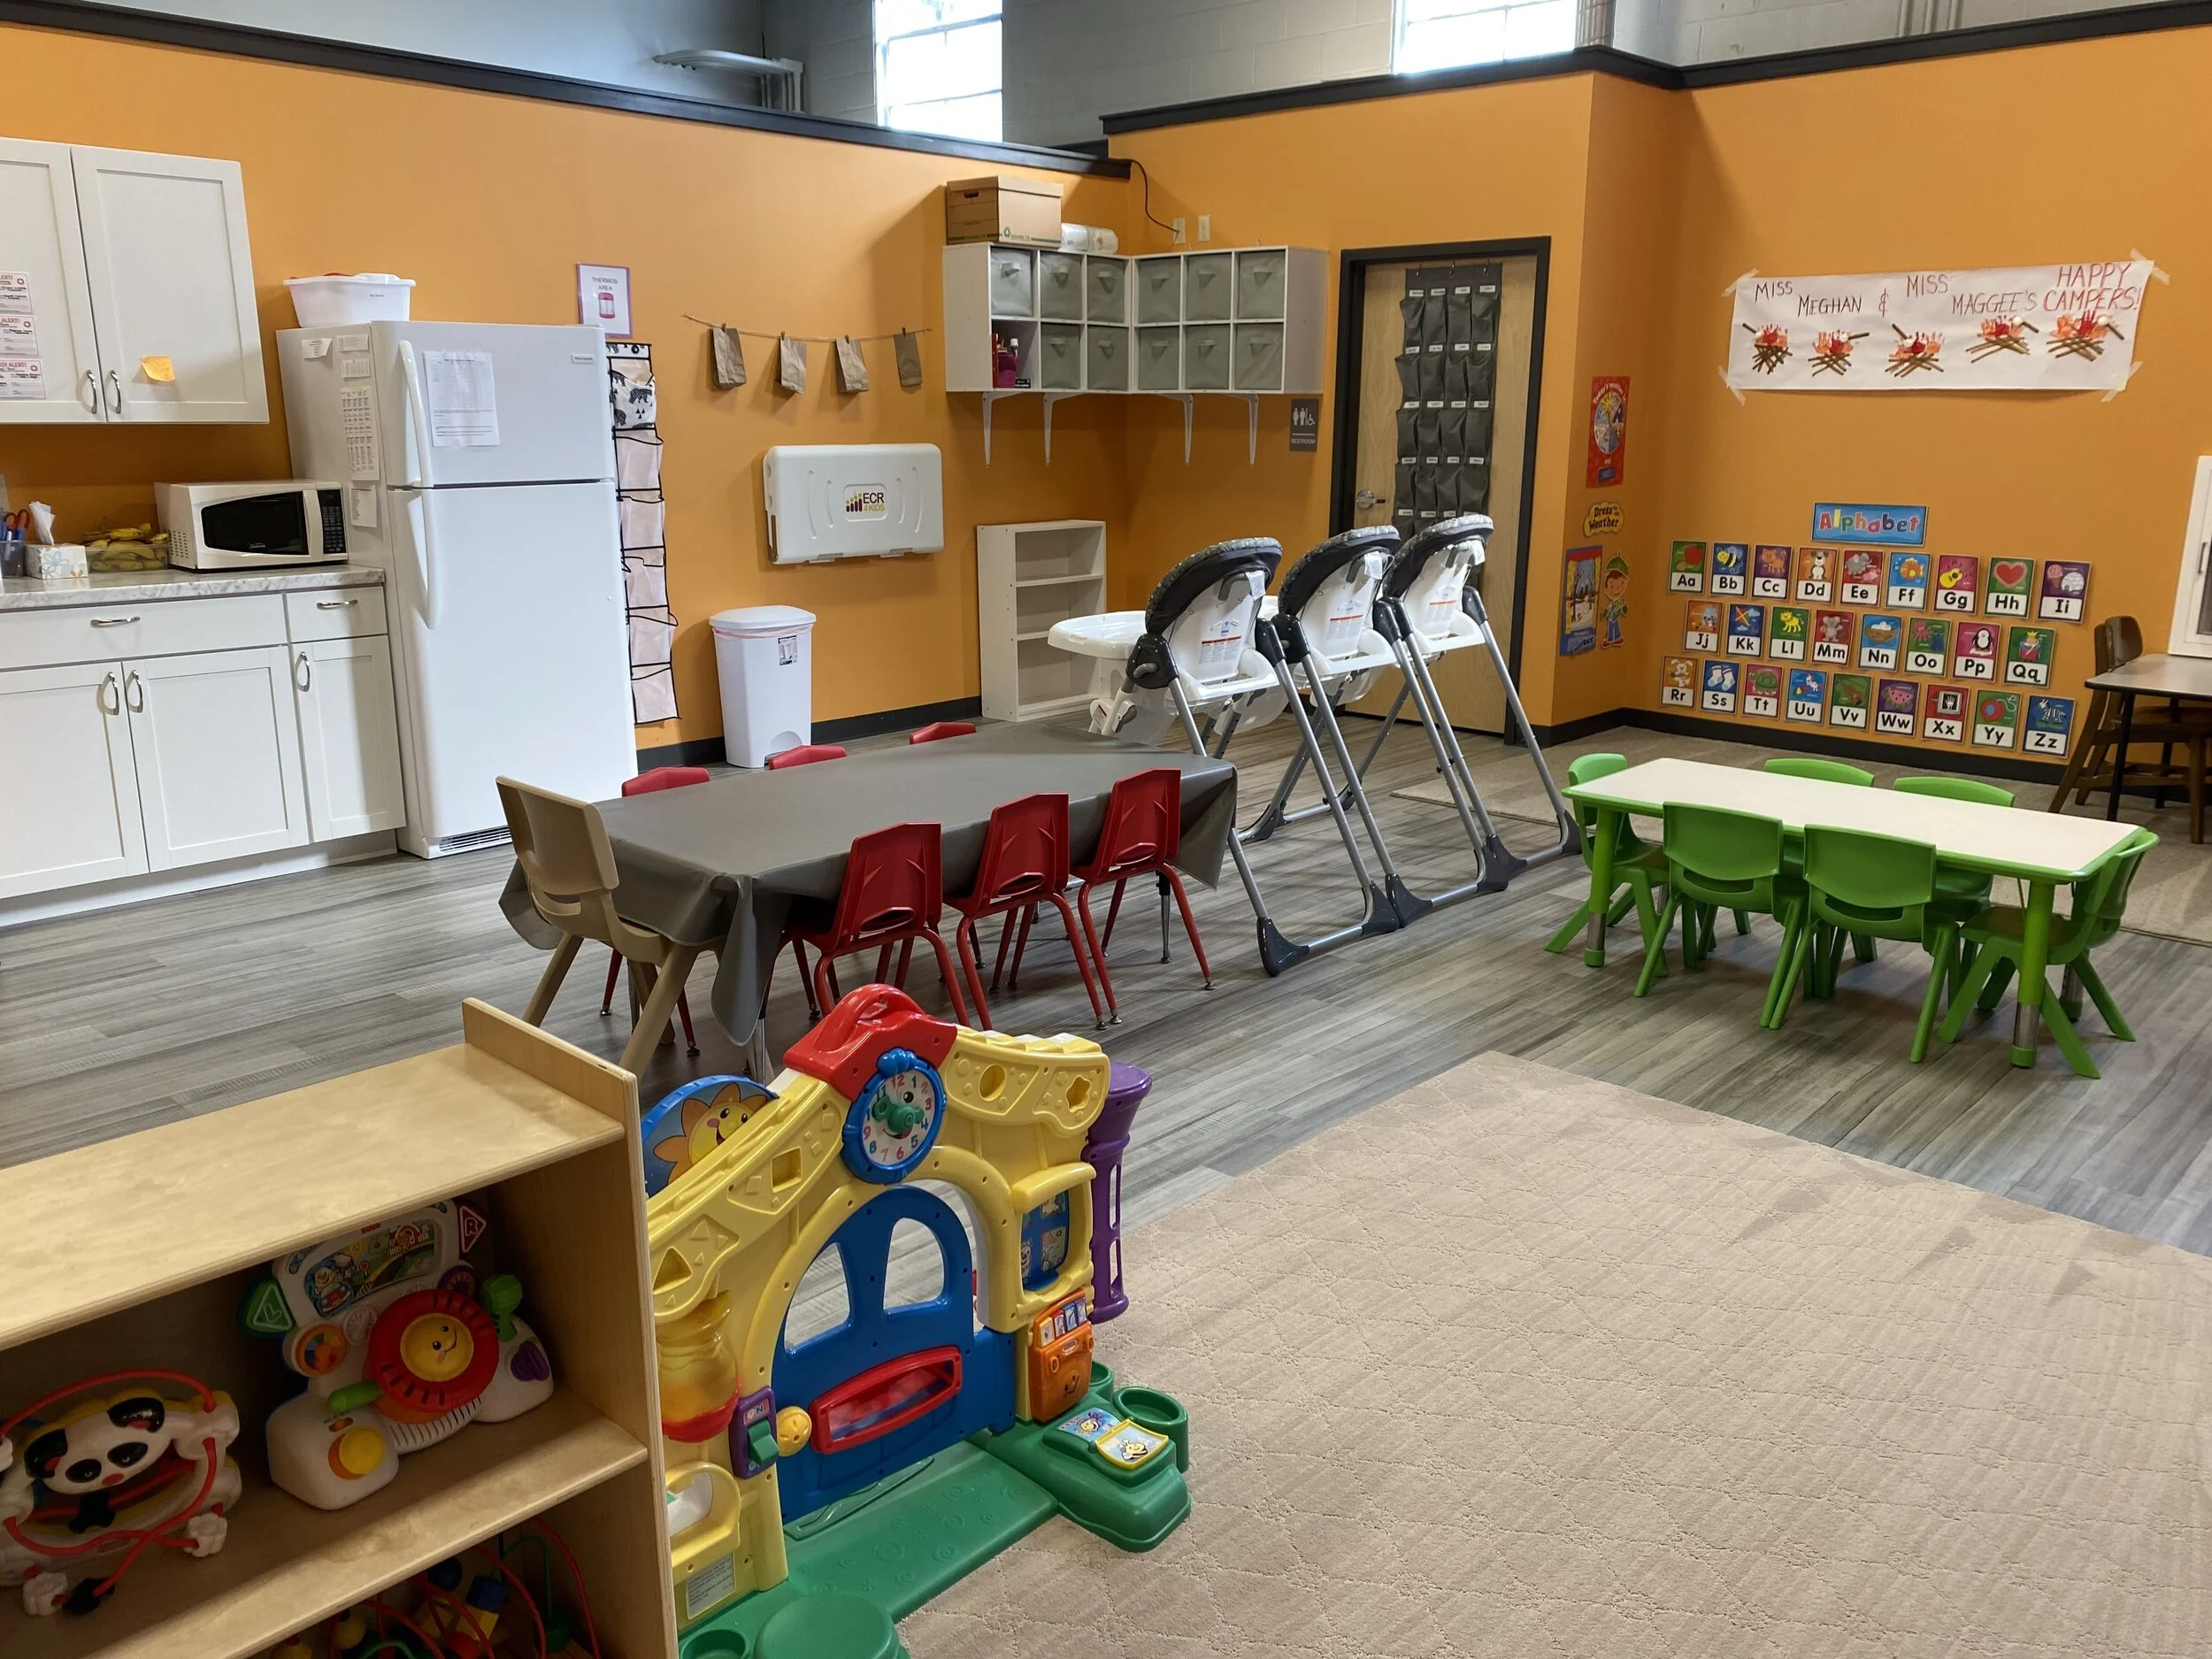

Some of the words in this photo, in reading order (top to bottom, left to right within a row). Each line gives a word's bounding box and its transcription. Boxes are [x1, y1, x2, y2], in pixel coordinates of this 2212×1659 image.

[2057, 262, 2132, 288] HAPPY
[1755, 280, 1793, 303] MISS
[1798, 294, 1862, 317] MEGHAN
[1907, 274, 1948, 297] MISS
[1952, 289, 2038, 317] MAGGEE'S
[2044, 287, 2141, 311] CAMPERS!
[864, 492, 885, 503] ECR
[1594, 506, 1613, 517] Dress
[1589, 516, 1619, 531] Weather
[1819, 508, 1919, 533] Alphabet
[1677, 573, 1695, 588] Aa
[1719, 575, 1738, 589] Bb
[1762, 580, 1779, 593] Cc
[1804, 582, 1824, 596] Dd
[1851, 585, 1869, 599] Ee
[1898, 588, 1915, 602] Ff
[1944, 591, 1968, 609] Gg
[1995, 595, 2019, 610] Hh
[2055, 599, 2070, 614] Ii
[1695, 634, 1709, 649] Jj
[1736, 637, 1754, 650] Kk
[1782, 641, 1794, 654] Ll
[1817, 644, 1846, 658] Mm
[1868, 649, 1889, 664] Nn
[1915, 654, 1938, 667] Oo
[1964, 658, 1985, 676] Pp
[2013, 664, 2040, 682] Qq
[1671, 688, 1686, 701] Rr
[1711, 693, 1727, 706] Ss
[1754, 697, 1769, 711] Tt
[1795, 702, 1816, 716] Uu
[1840, 708, 1858, 722] Vv
[1881, 714, 1910, 728] Ww
[1932, 720, 1955, 734] Xx
[1984, 726, 2005, 743] Yy
[2034, 733, 2058, 749] Zz
[890, 1074, 904, 1088] 12
[911, 1076, 917, 1088] 1
[921, 1082, 929, 1094] 2
[926, 1097, 932, 1110] 3
[921, 1118, 928, 1130] 4
[864, 1125, 871, 1140] 9
[869, 1141, 877, 1154] 8
[911, 1135, 918, 1148] 5
[881, 1148, 888, 1161] 7
[896, 1147, 904, 1160] 6
[464, 1216, 478, 1237] R
[747, 1403, 764, 1419] ON
